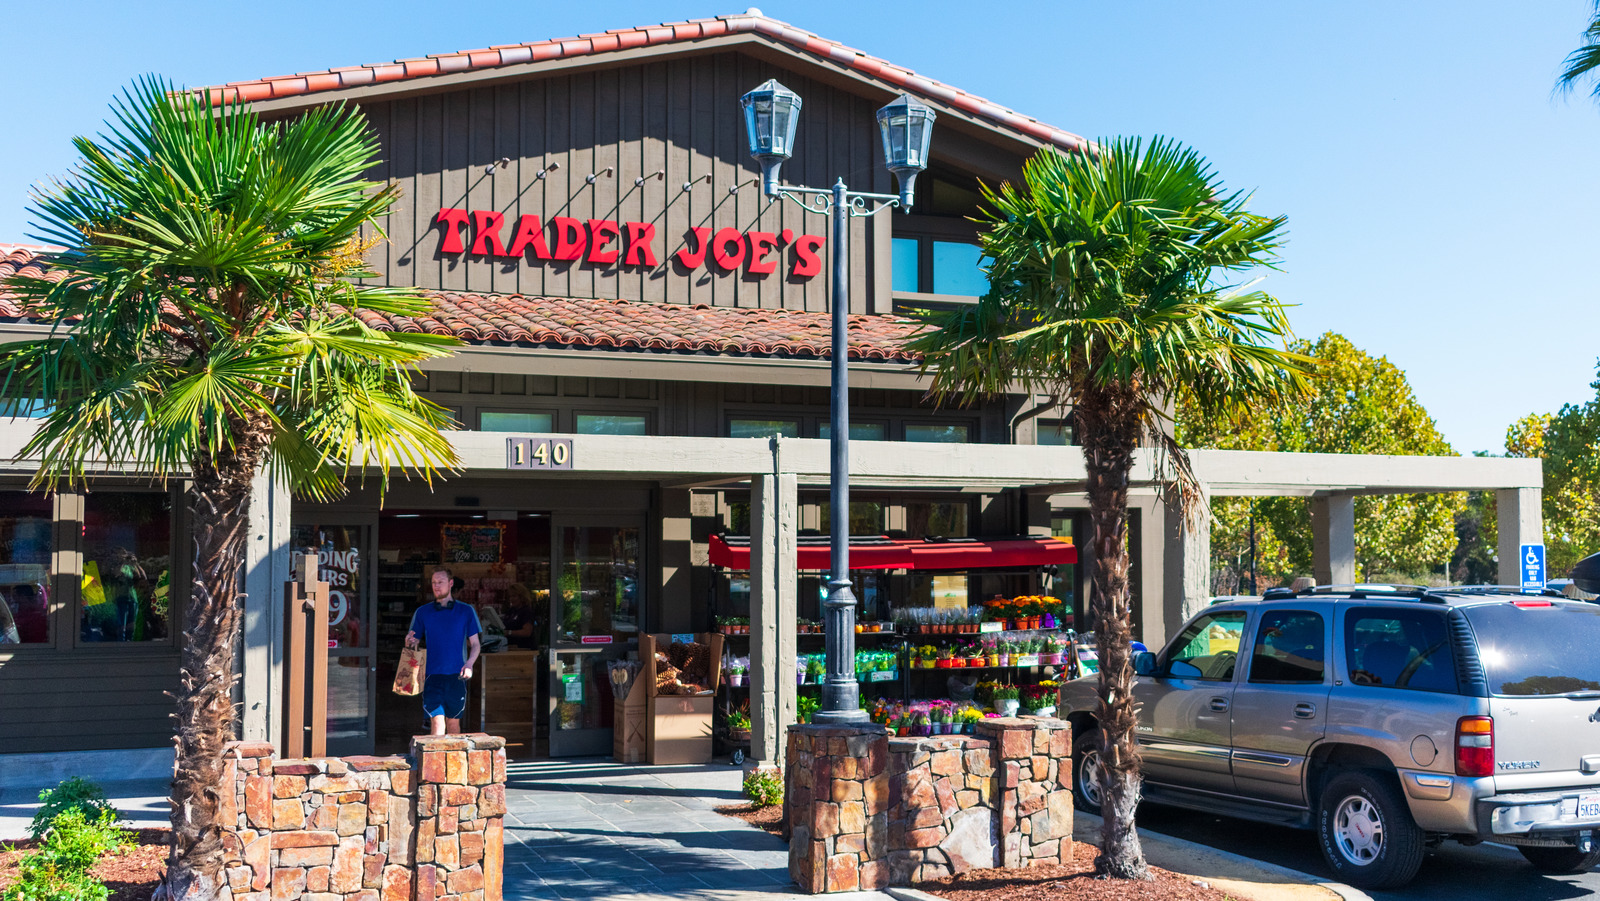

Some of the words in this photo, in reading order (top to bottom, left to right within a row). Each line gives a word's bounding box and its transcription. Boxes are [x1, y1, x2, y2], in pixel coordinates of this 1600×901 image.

[437, 208, 658, 267] TRADER
[676, 225, 827, 277] JOE'S
[515, 442, 569, 465] 140
[1497, 760, 1541, 770] YUKON
[1580, 803, 1600, 817] 5KEB
